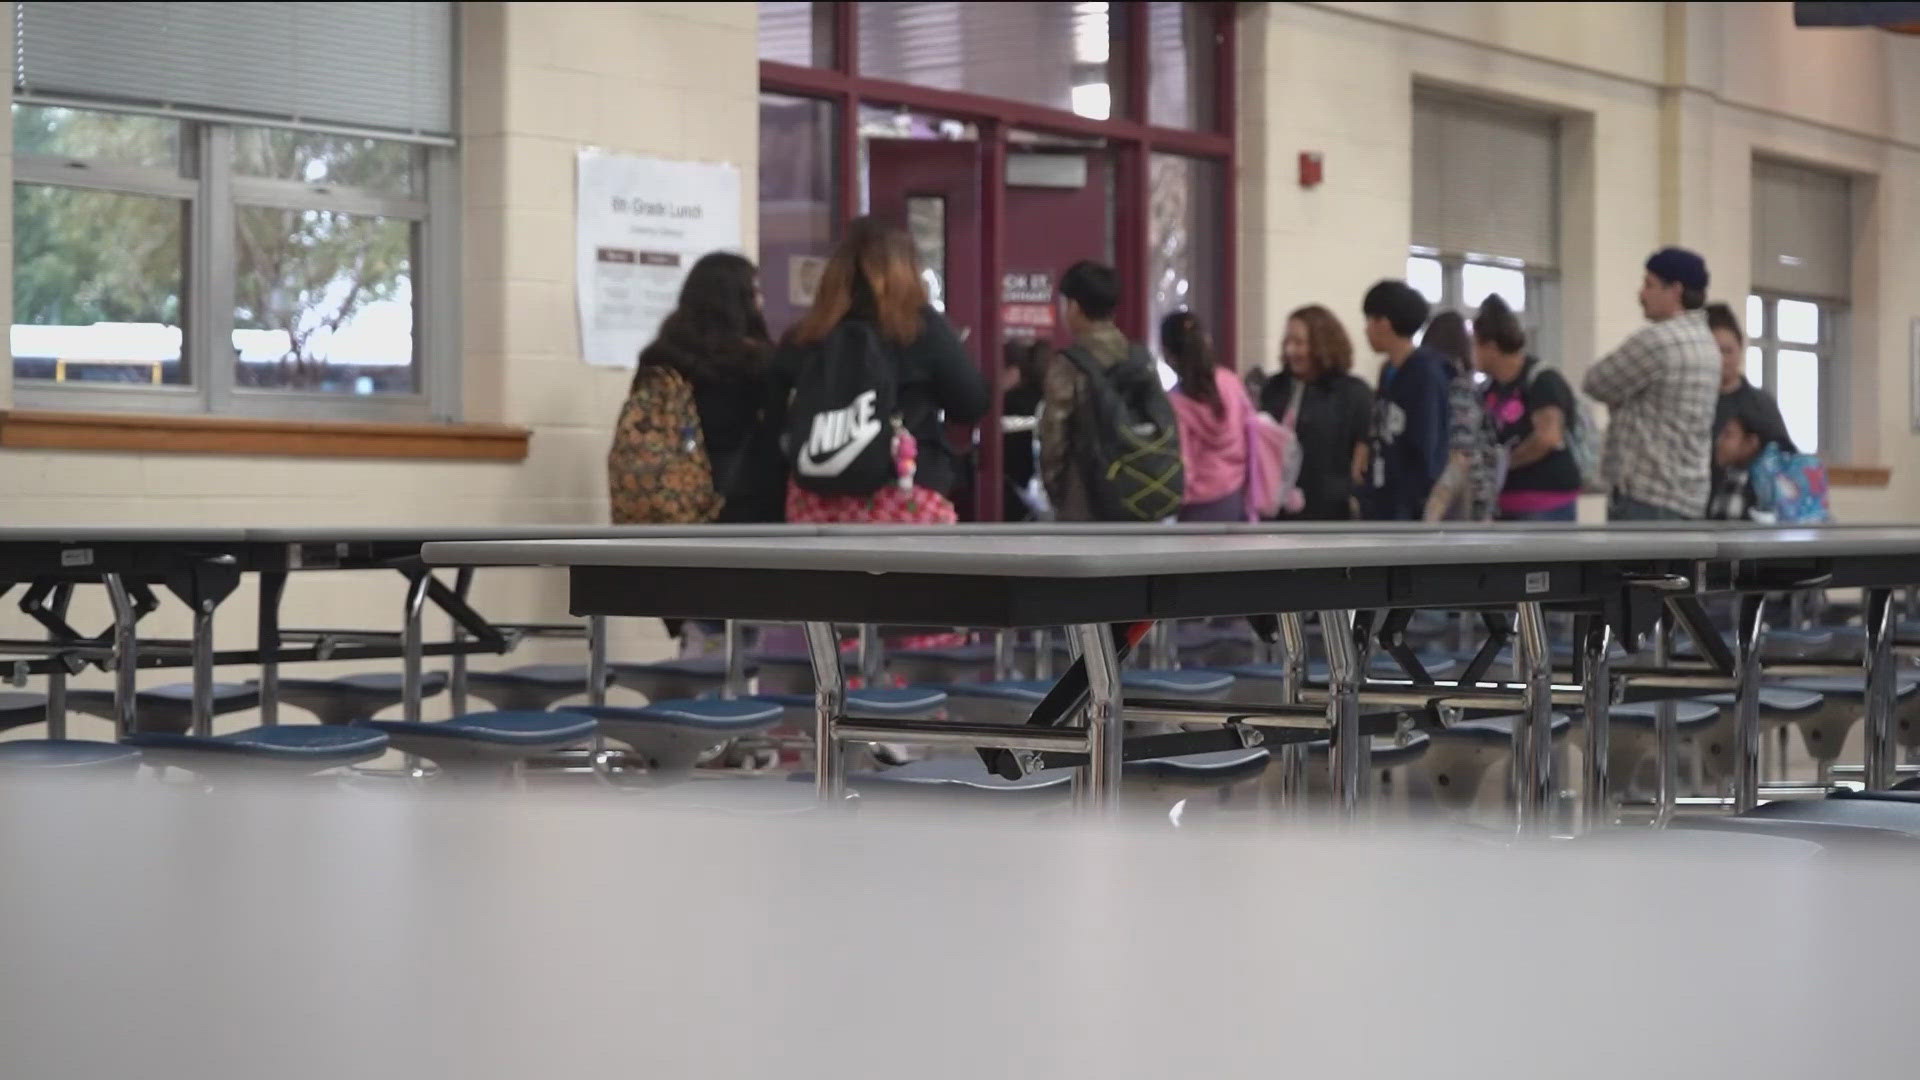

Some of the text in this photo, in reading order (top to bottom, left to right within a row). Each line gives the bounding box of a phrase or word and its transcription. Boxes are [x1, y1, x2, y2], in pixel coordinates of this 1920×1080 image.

[632, 197, 666, 217] Grade
[669, 201, 704, 220] Lunch
[808, 389, 882, 457] NIKE
